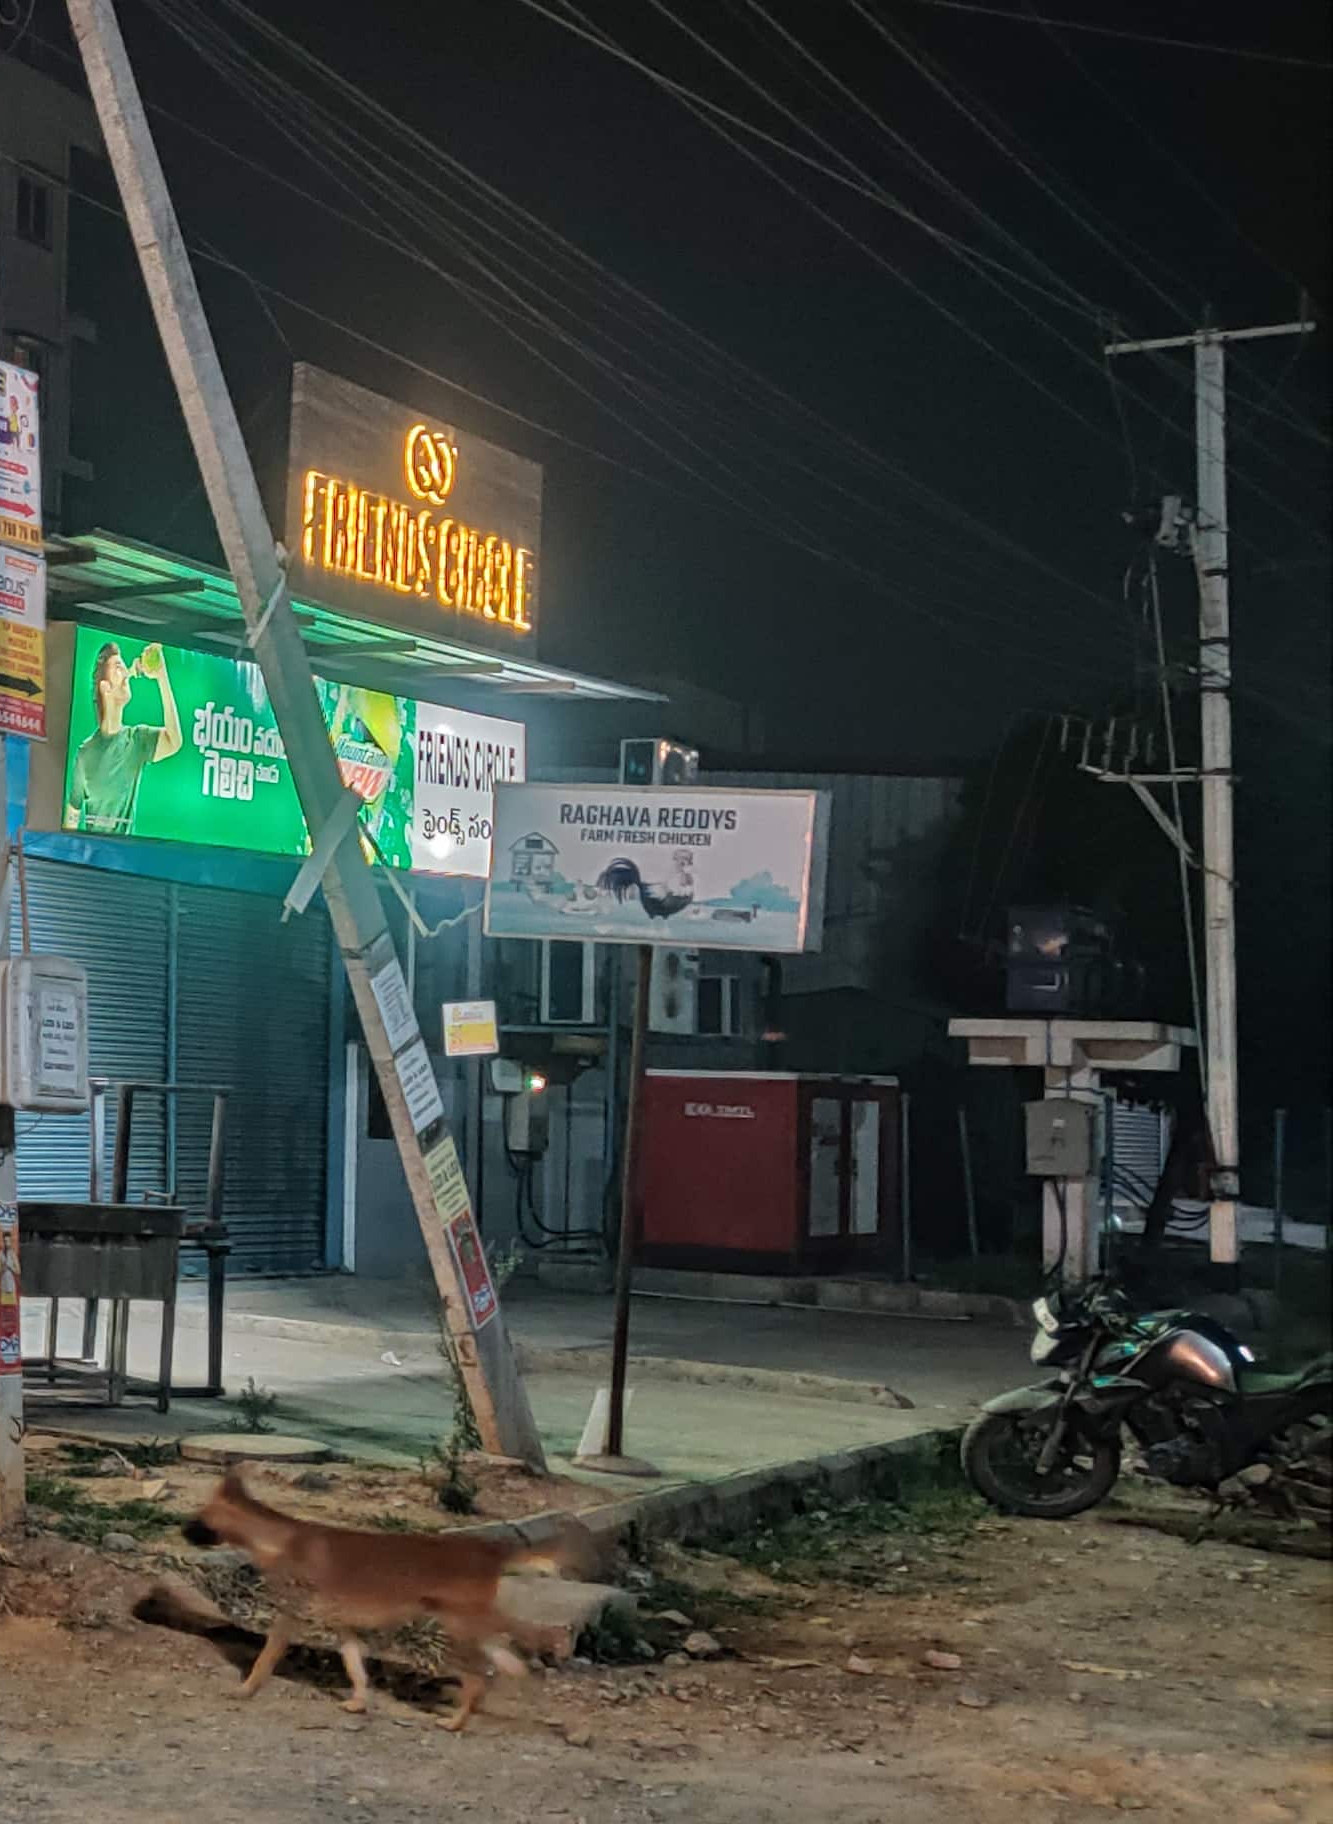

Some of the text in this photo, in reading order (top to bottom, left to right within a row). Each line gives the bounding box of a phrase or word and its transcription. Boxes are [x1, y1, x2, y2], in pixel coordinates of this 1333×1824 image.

[303, 469, 533, 630] FRIENDS CIRCLE
[418, 731, 515, 792] FRIENDS CIRCLE
[560, 803, 737, 831] RAGHAVA REDDYS
[580, 828, 712, 847] FARM FRESH CHICKEN
